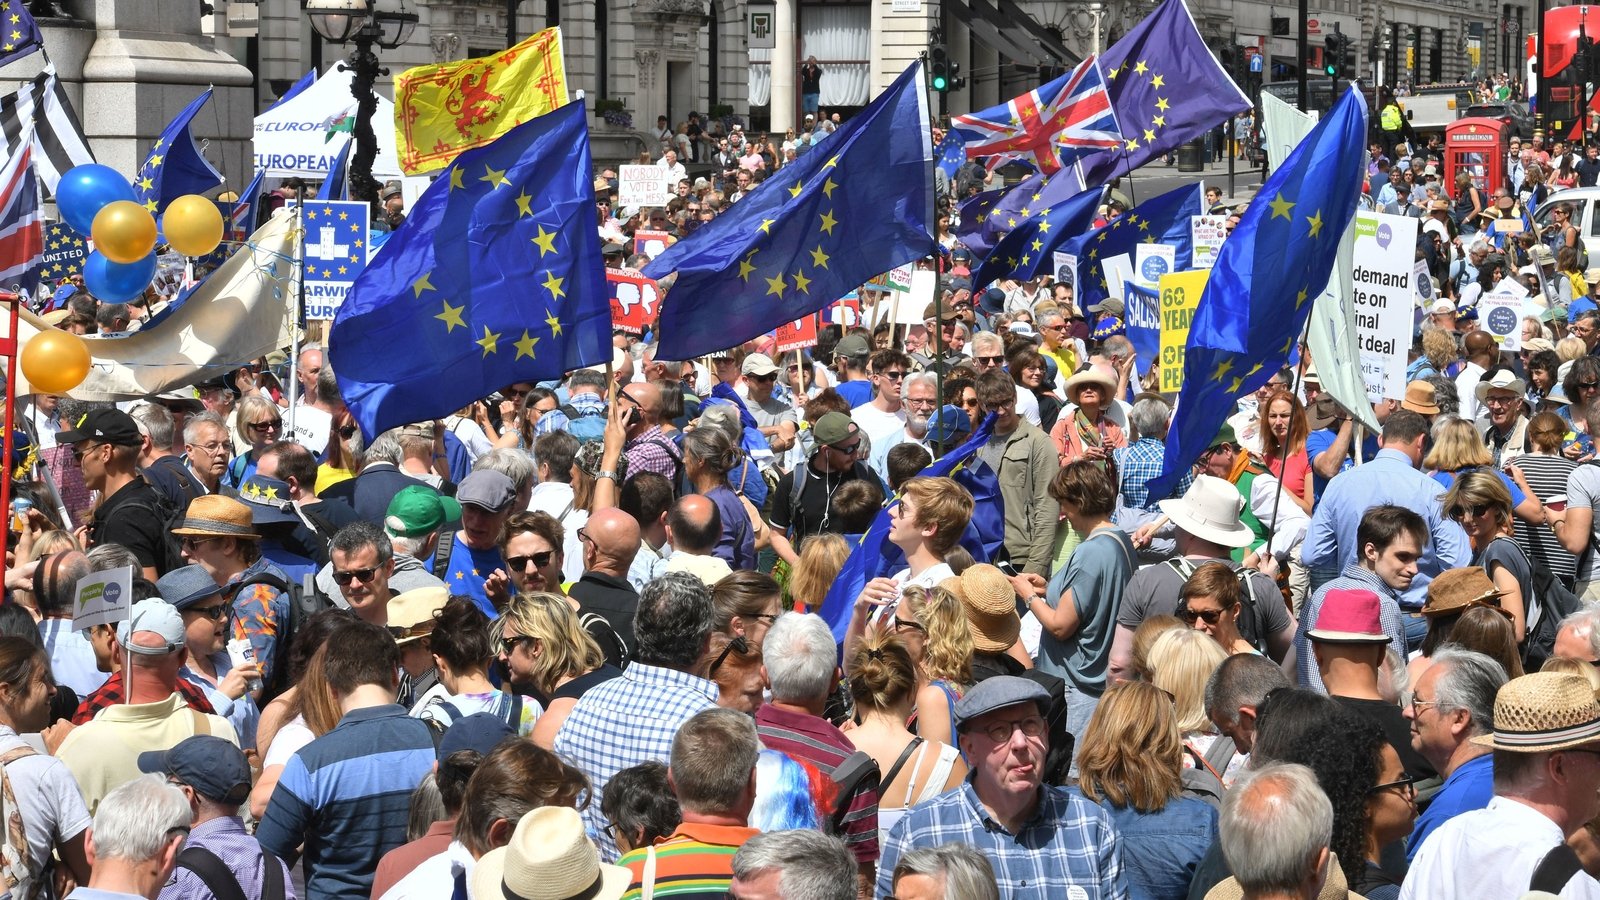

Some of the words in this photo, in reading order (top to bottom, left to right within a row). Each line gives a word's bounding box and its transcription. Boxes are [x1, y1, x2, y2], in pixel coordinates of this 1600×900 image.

[264, 122, 325, 132] EUROP
[624, 167, 665, 181] NOBODY
[629, 181, 659, 192] VOTED
[1378, 232, 1391, 240] Vote
[42, 249, 83, 262] UNITED
[612, 269, 643, 279] EUROPEAN
[1353, 265, 1409, 289] demand
[1163, 287, 1185, 307] 60
[1353, 287, 1367, 306] te
[1369, 293, 1387, 309] on
[1164, 308, 1196, 331] YEAR
[1355, 309, 1379, 330] inal
[783, 339, 817, 351] EUROPEAN
[1365, 335, 1395, 355] deal
[1361, 362, 1372, 375] xit
[282, 418, 308, 436] Deand
